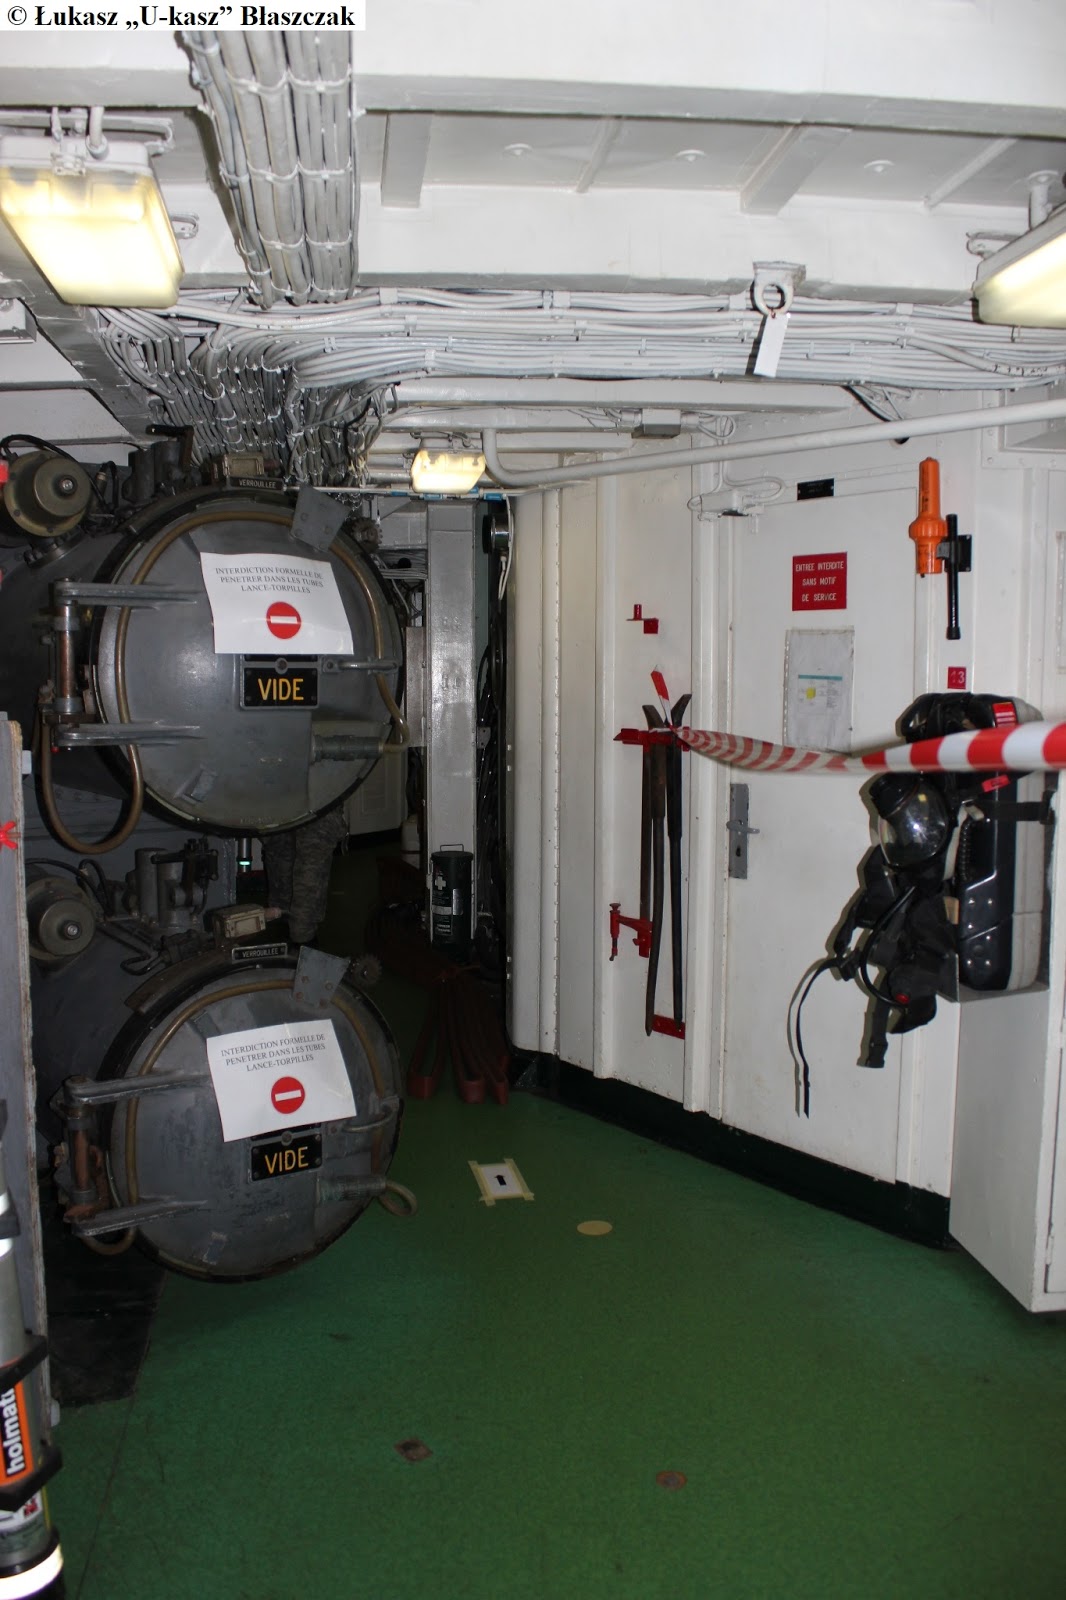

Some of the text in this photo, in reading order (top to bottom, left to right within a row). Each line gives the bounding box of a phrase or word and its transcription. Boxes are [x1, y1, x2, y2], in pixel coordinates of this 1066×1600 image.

[795, 561, 844, 572] ENTREE INTERDITE
[215, 567, 324, 580] INTERDICTION FORMELLE DE
[264, 576, 286, 584] DANS
[302, 578, 324, 588] TUBES
[802, 576, 837, 586] SANS MOTIF
[241, 584, 311, 594] LANCE-TORPILLES
[802, 592, 837, 602] DE SERVICE
[257, 678, 304, 701] VIDE
[221, 1034, 325, 1057] INTERDICTION FORMELLE DE
[226, 1043, 326, 1066] PENETRER DANS LES TUBES
[246, 1054, 314, 1072] LANCE-TORPILLES
[265, 1146, 309, 1174] VIDE
